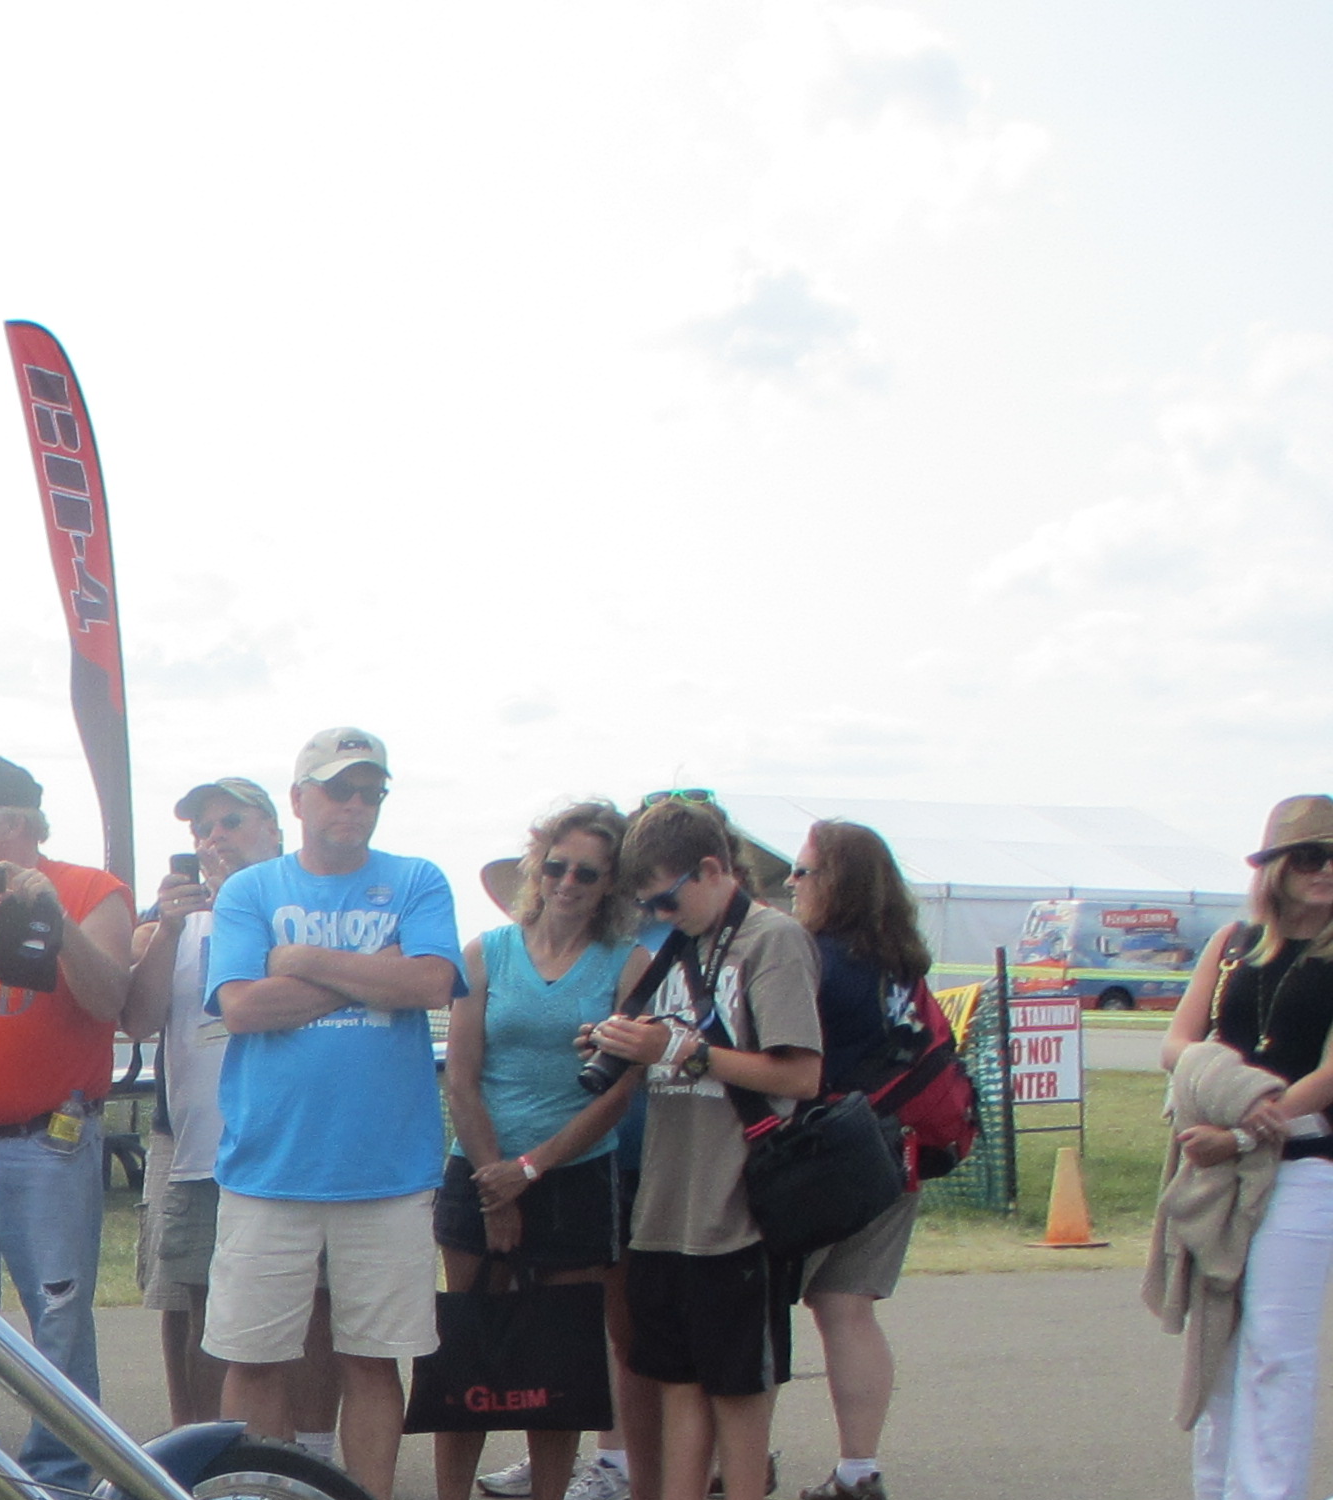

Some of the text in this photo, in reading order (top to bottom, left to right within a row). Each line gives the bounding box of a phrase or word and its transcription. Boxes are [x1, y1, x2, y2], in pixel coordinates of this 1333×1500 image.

[1028, 1035, 1064, 1066] NOT
[1012, 1071, 1058, 1101] NTER
[464, 1385, 548, 1412] GLEIM
